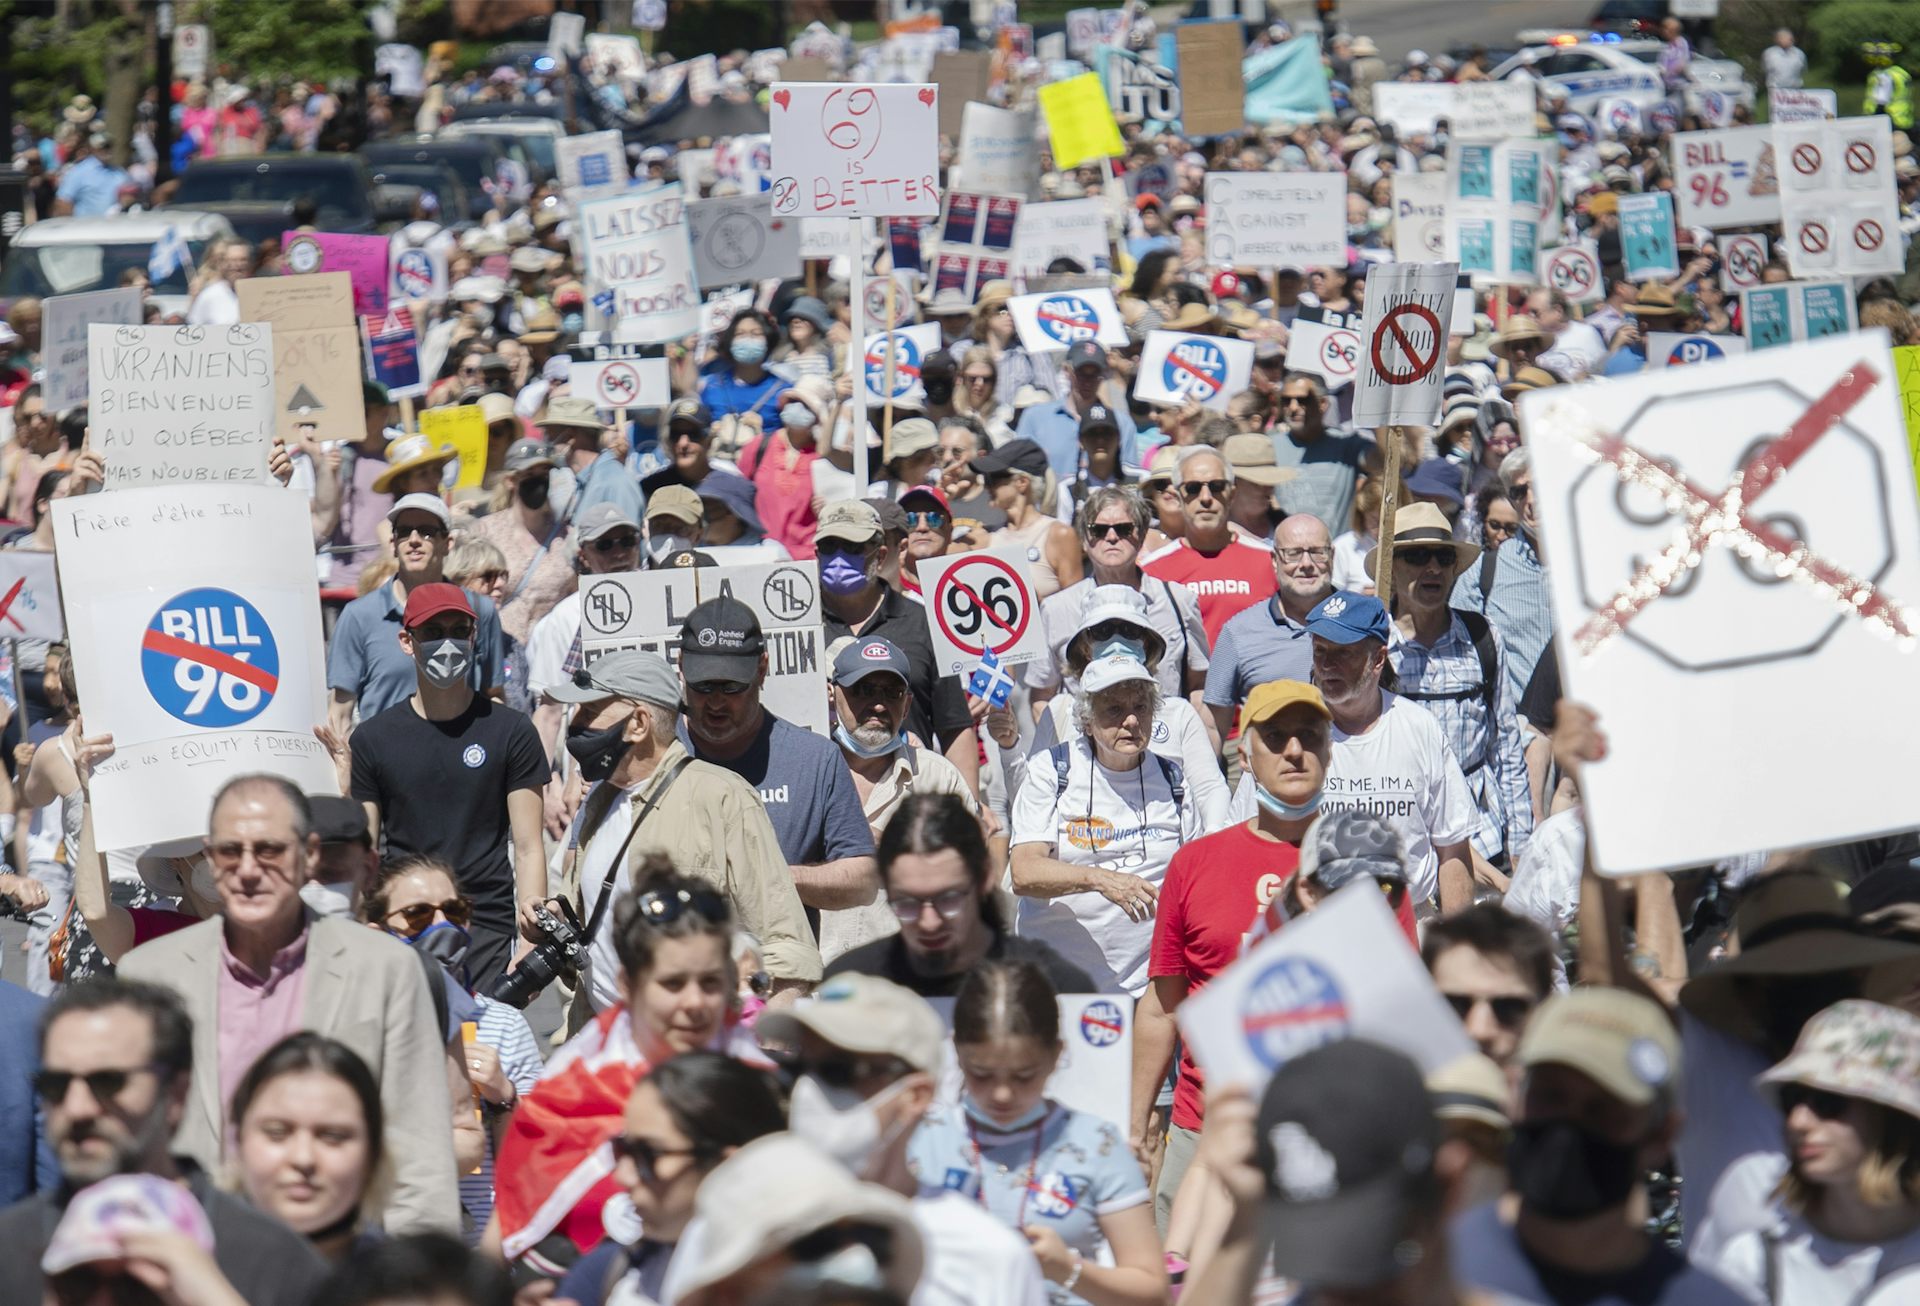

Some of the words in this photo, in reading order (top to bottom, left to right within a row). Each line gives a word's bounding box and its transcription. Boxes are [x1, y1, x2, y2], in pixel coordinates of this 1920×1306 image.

[821, 88, 882, 160] 69
[847, 157, 864, 175] is
[1686, 141, 1727, 168] BILL
[814, 175, 940, 211] BETTER
[1690, 171, 1729, 207] 96
[596, 249, 666, 280] NOUS
[1042, 299, 1090, 319] BILL
[119, 327, 140, 341] 96
[179, 327, 202, 341] 96
[1051, 317, 1095, 343] 96
[1175, 342, 1223, 370] BILL
[1328, 343, 1357, 362] 96
[605, 374, 633, 392] 96
[1173, 366, 1215, 400] 96
[100, 389, 254, 414] BIENVENUE
[104, 427, 135, 448] AU
[105, 465, 142, 481] MAIS
[152, 461, 258, 481] N'OUBLIEZ
[72, 509, 131, 538] Fière
[1182, 579, 1250, 594] ANADA
[947, 577, 1018, 635] 96
[161, 606, 262, 646] BILL
[719, 630, 745, 639] Ashfield
[174, 651, 261, 716] 96
[170, 737, 243, 761] EQUITY
[1350, 778, 1376, 791] ME,
[1381, 776, 1400, 790] I'M
[1404, 778, 1415, 790] A
[1086, 1004, 1121, 1020] BILL
